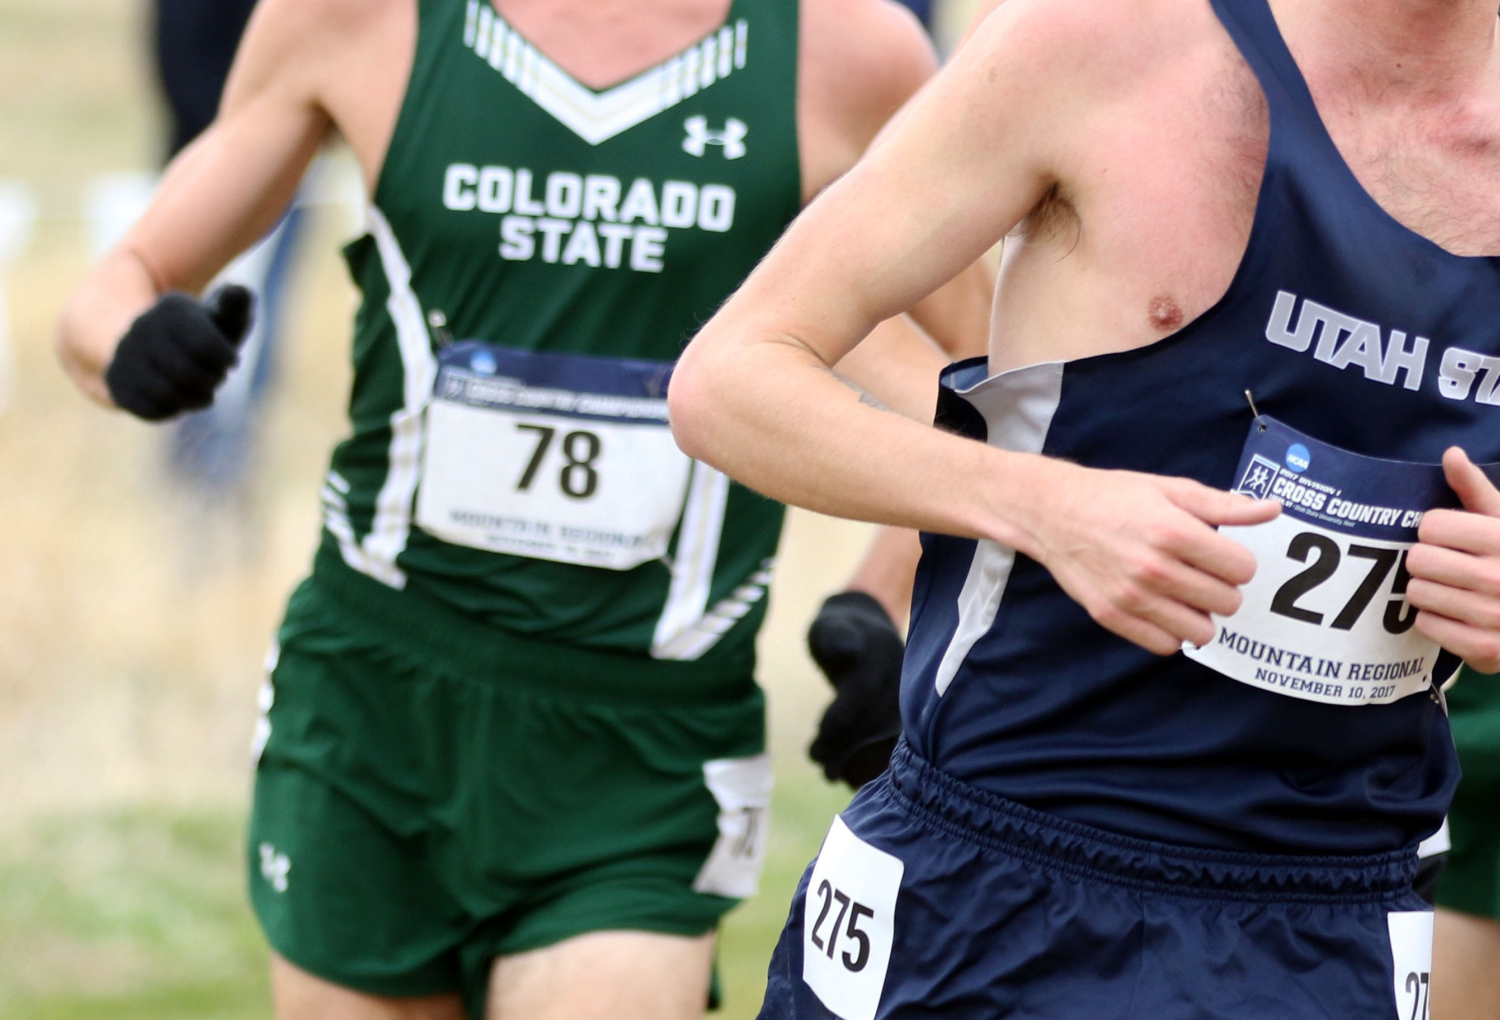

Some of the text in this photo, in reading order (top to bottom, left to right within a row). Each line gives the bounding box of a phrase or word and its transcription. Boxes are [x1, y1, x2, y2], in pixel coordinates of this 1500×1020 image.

[443, 163, 736, 233] COLORADO
[499, 217, 668, 273] STATE
[1265, 290, 1430, 391] UTAH
[512, 423, 601, 501] 78
[1299, 476, 1336, 495] DIVISION
[1272, 477, 1327, 511] CROSS
[1326, 497, 1402, 527] COUNTRY
[1218, 627, 1425, 681] MOUNTAIN REGIONAL
[1255, 668, 1396, 700] NOVEMBER 10, 2017
[811, 878, 875, 973] 275
[1405, 971, 1430, 1020] 27
